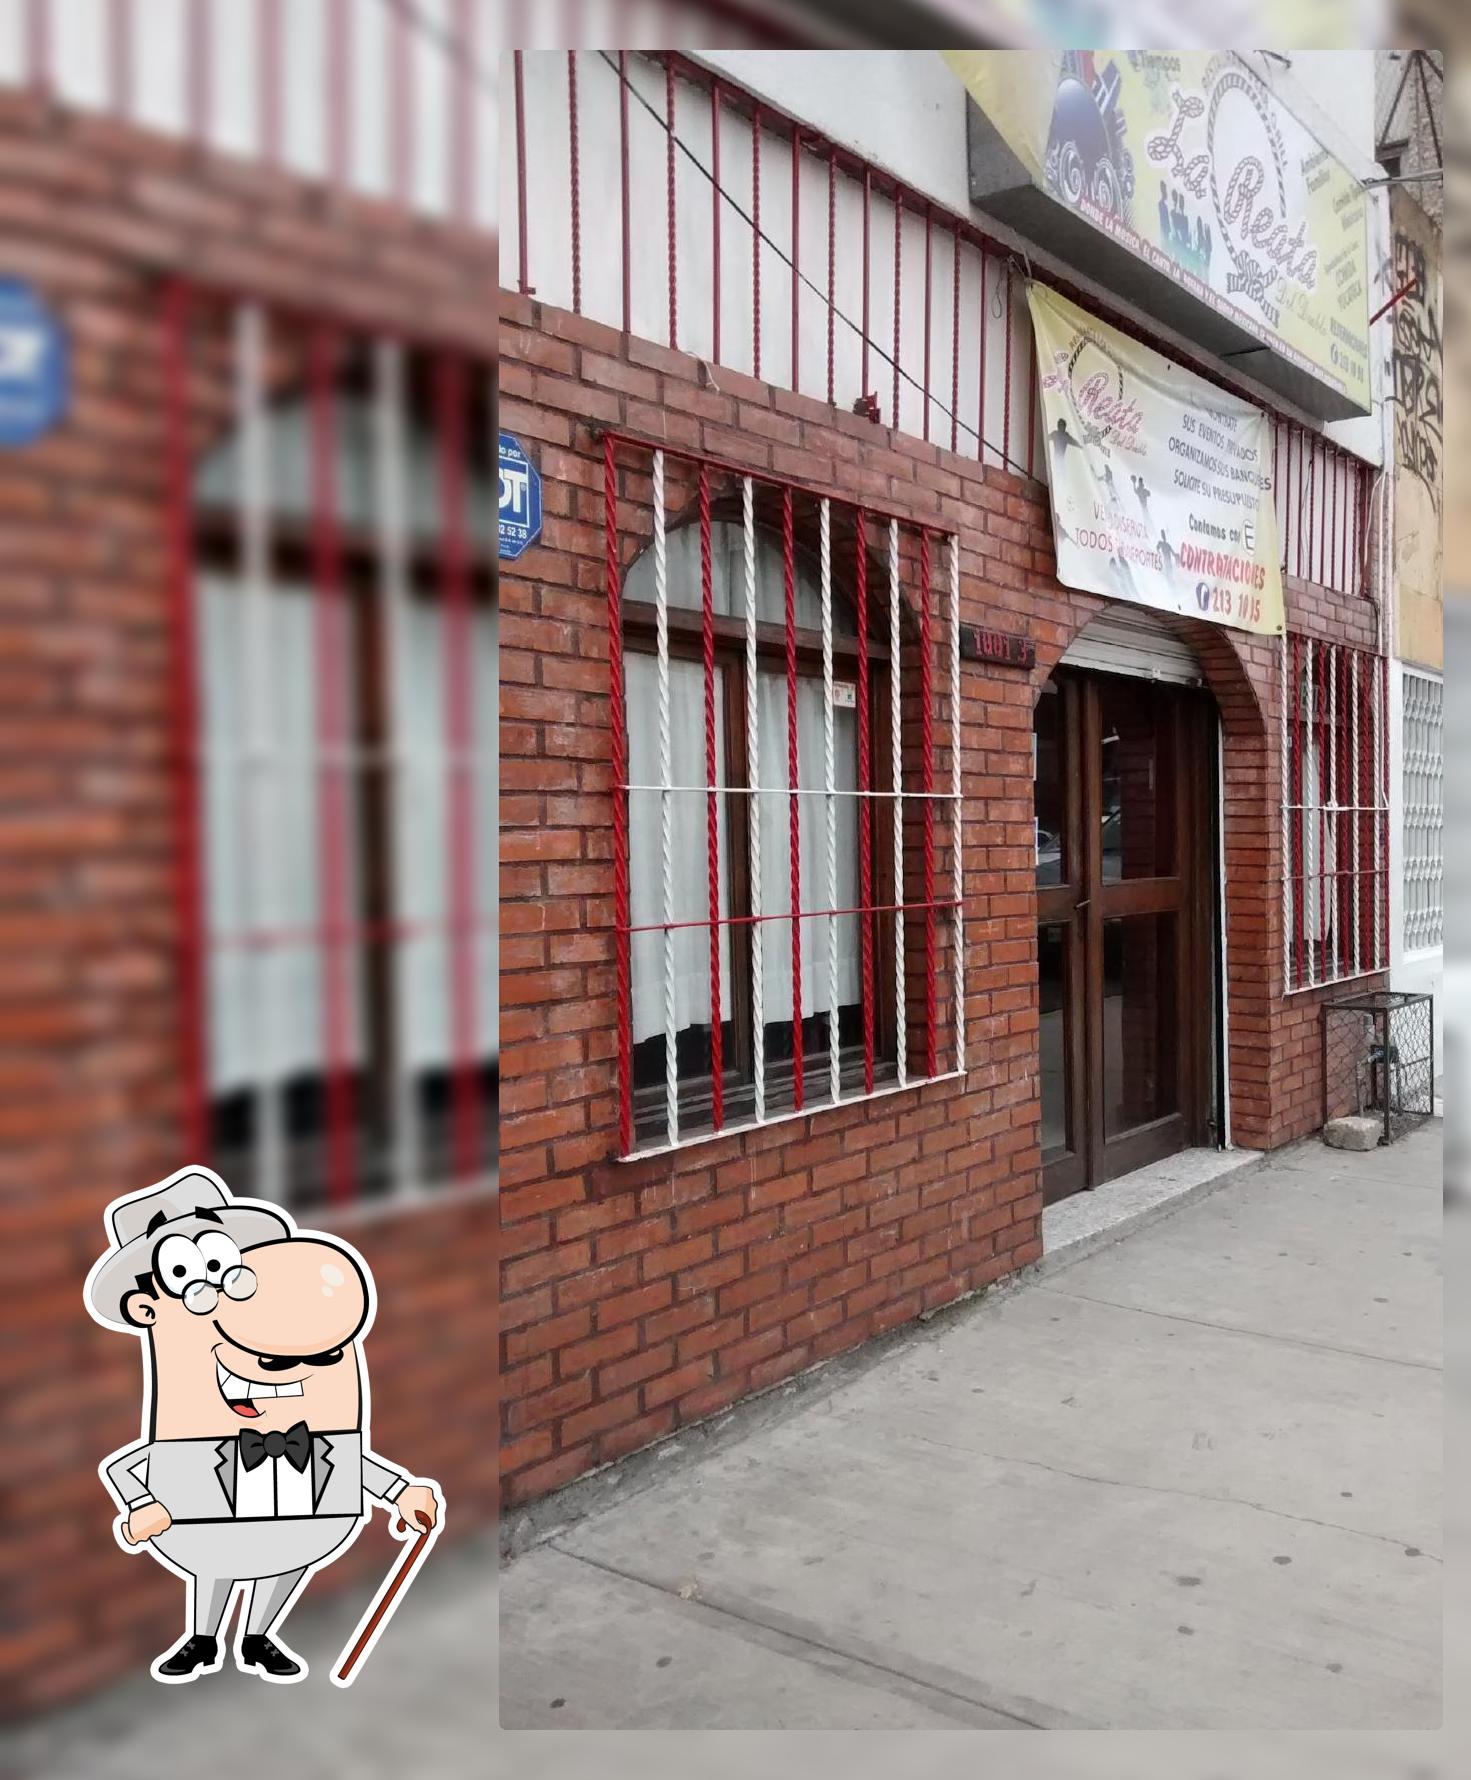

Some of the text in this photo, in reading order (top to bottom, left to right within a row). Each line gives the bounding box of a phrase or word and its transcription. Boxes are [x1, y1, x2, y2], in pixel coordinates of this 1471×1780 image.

[1147, 88, 1210, 201] La
[1222, 156, 1317, 291] Reata
[1079, 372, 1143, 433] Reata
[1182, 414, 1197, 434] SUS
[1198, 422, 1226, 450] EVENTOS
[508, 447, 521, 458] por
[1168, 436, 1218, 473] ORGANIZAMOS
[1173, 468, 1201, 495] SOLICITE
[1201, 480, 1212, 498] SU
[507, 526, 517, 537] 52
[518, 528, 528, 539] 38
[1074, 527, 1114, 553] TODOS
[1189, 513, 1227, 541] Contamos
[1212, 586, 1232, 615] 213
